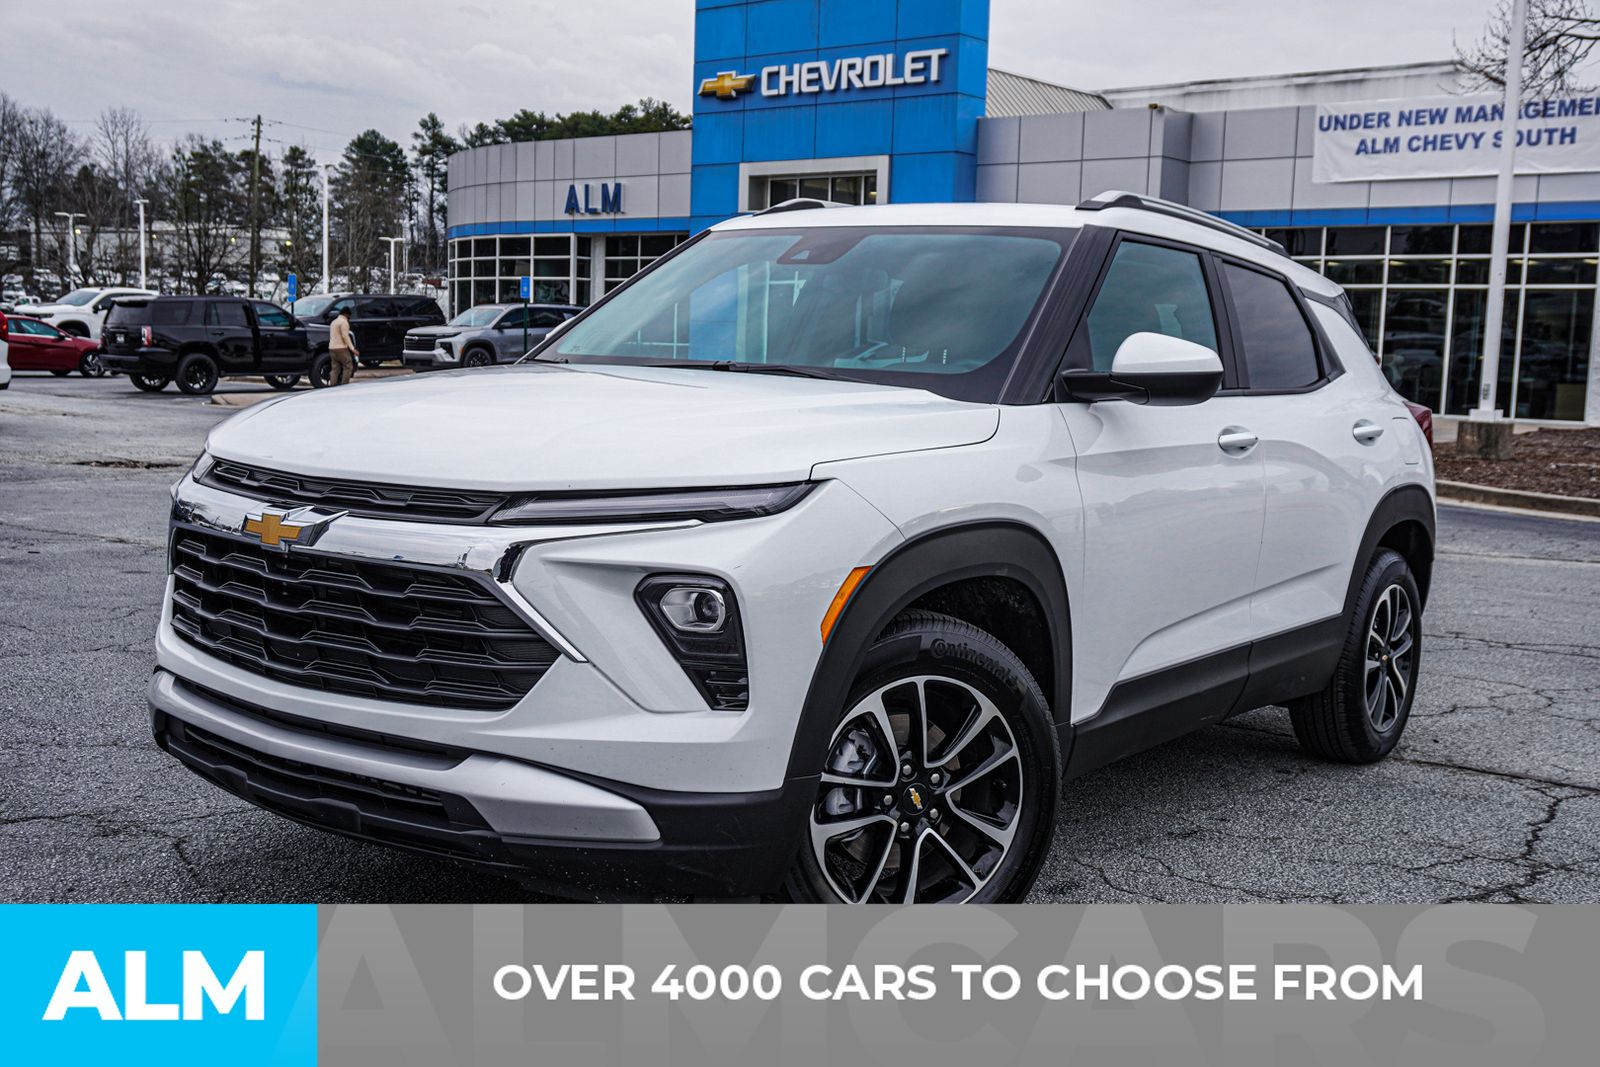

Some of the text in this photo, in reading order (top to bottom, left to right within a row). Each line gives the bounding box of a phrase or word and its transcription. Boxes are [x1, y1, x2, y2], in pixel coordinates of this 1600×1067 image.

[761, 48, 947, 97] CHEVROLET
[1318, 97, 1600, 132] UNDER NEW MANGEME
[1355, 137, 1400, 156] ALM
[1407, 132, 1486, 153] CHEVY
[564, 182, 624, 215] ALM
[930, 638, 1013, 684] Continental
